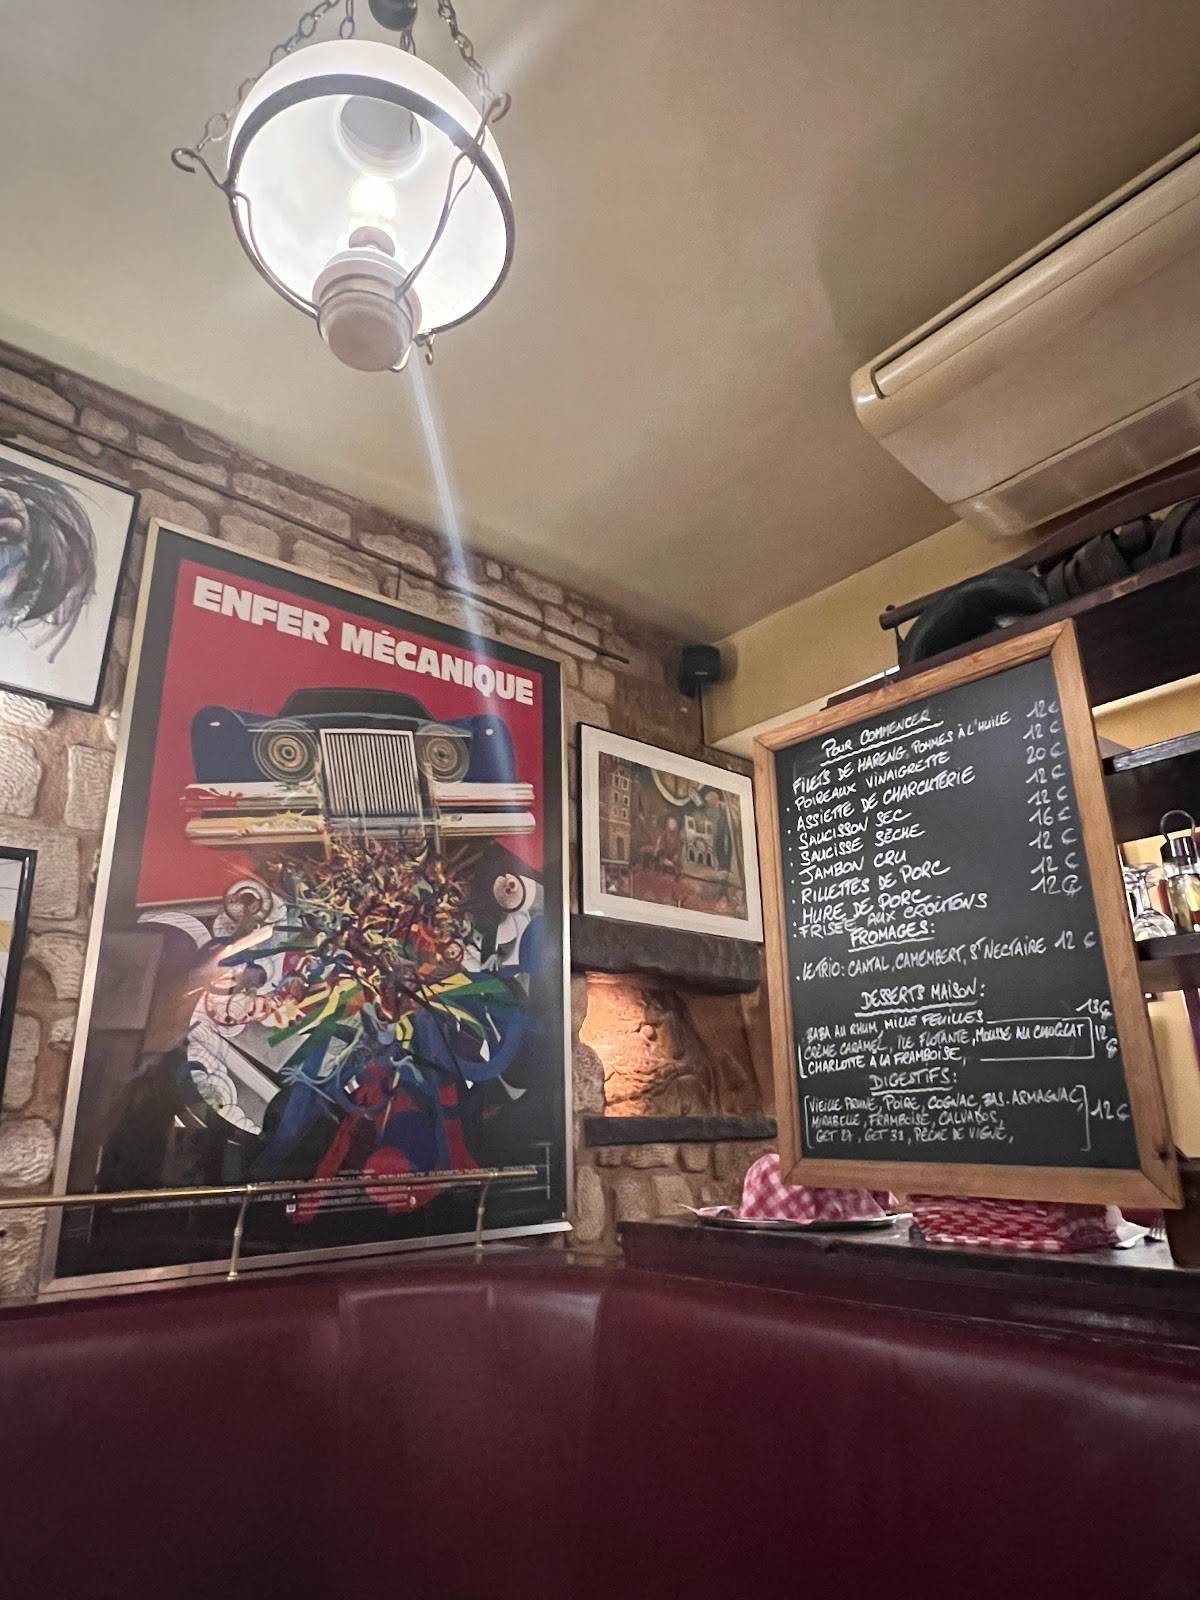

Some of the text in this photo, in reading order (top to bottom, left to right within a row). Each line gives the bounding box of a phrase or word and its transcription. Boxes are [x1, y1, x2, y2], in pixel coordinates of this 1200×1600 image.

[192, 575, 534, 706] ENFER MÉCANIQUE
[792, 769, 831, 795] FILETS
[838, 762, 854, 781] DE
[911, 731, 953, 754] POMMES
[822, 738, 853, 758] POUR
[795, 782, 856, 811] POIREAUX
[866, 751, 950, 788] VINAIGRETTE
[796, 801, 855, 831] ASSIETTE
[860, 792, 878, 813] DE
[882, 766, 976, 805] CHARCUTERIE
[798, 816, 868, 850] SAUCISSON
[875, 808, 913, 828] SEC
[800, 837, 864, 866] SAUCISSE
[798, 856, 864, 886] JAMBON
[873, 850, 907, 868] CRU
[801, 877, 870, 904] RILLETTES
[878, 873, 897, 891] DE
[899, 860, 951, 884] PORC
[802, 902, 847, 925] HURE
[852, 897, 874, 919] DE
[878, 888, 933, 910] PORC
[867, 910, 896, 927] AUX
[984, 935, 1047, 960] NECTAIRE
[860, 984, 925, 1010] DESSERTS
[806, 1026, 831, 1043] BABA
[835, 1025, 846, 1037] AU
[884, 1015, 917, 1029] MILLE
[922, 1009, 983, 1027] FEUILLES
[1015, 1026, 1030, 1039] AU
[807, 1055, 865, 1075] CHARLOTTE
[880, 1054, 891, 1067] LA
[809, 1097, 842, 1112] VIEILLE
[816, 1129, 838, 1142] GET
[865, 1128, 888, 1141] GET
